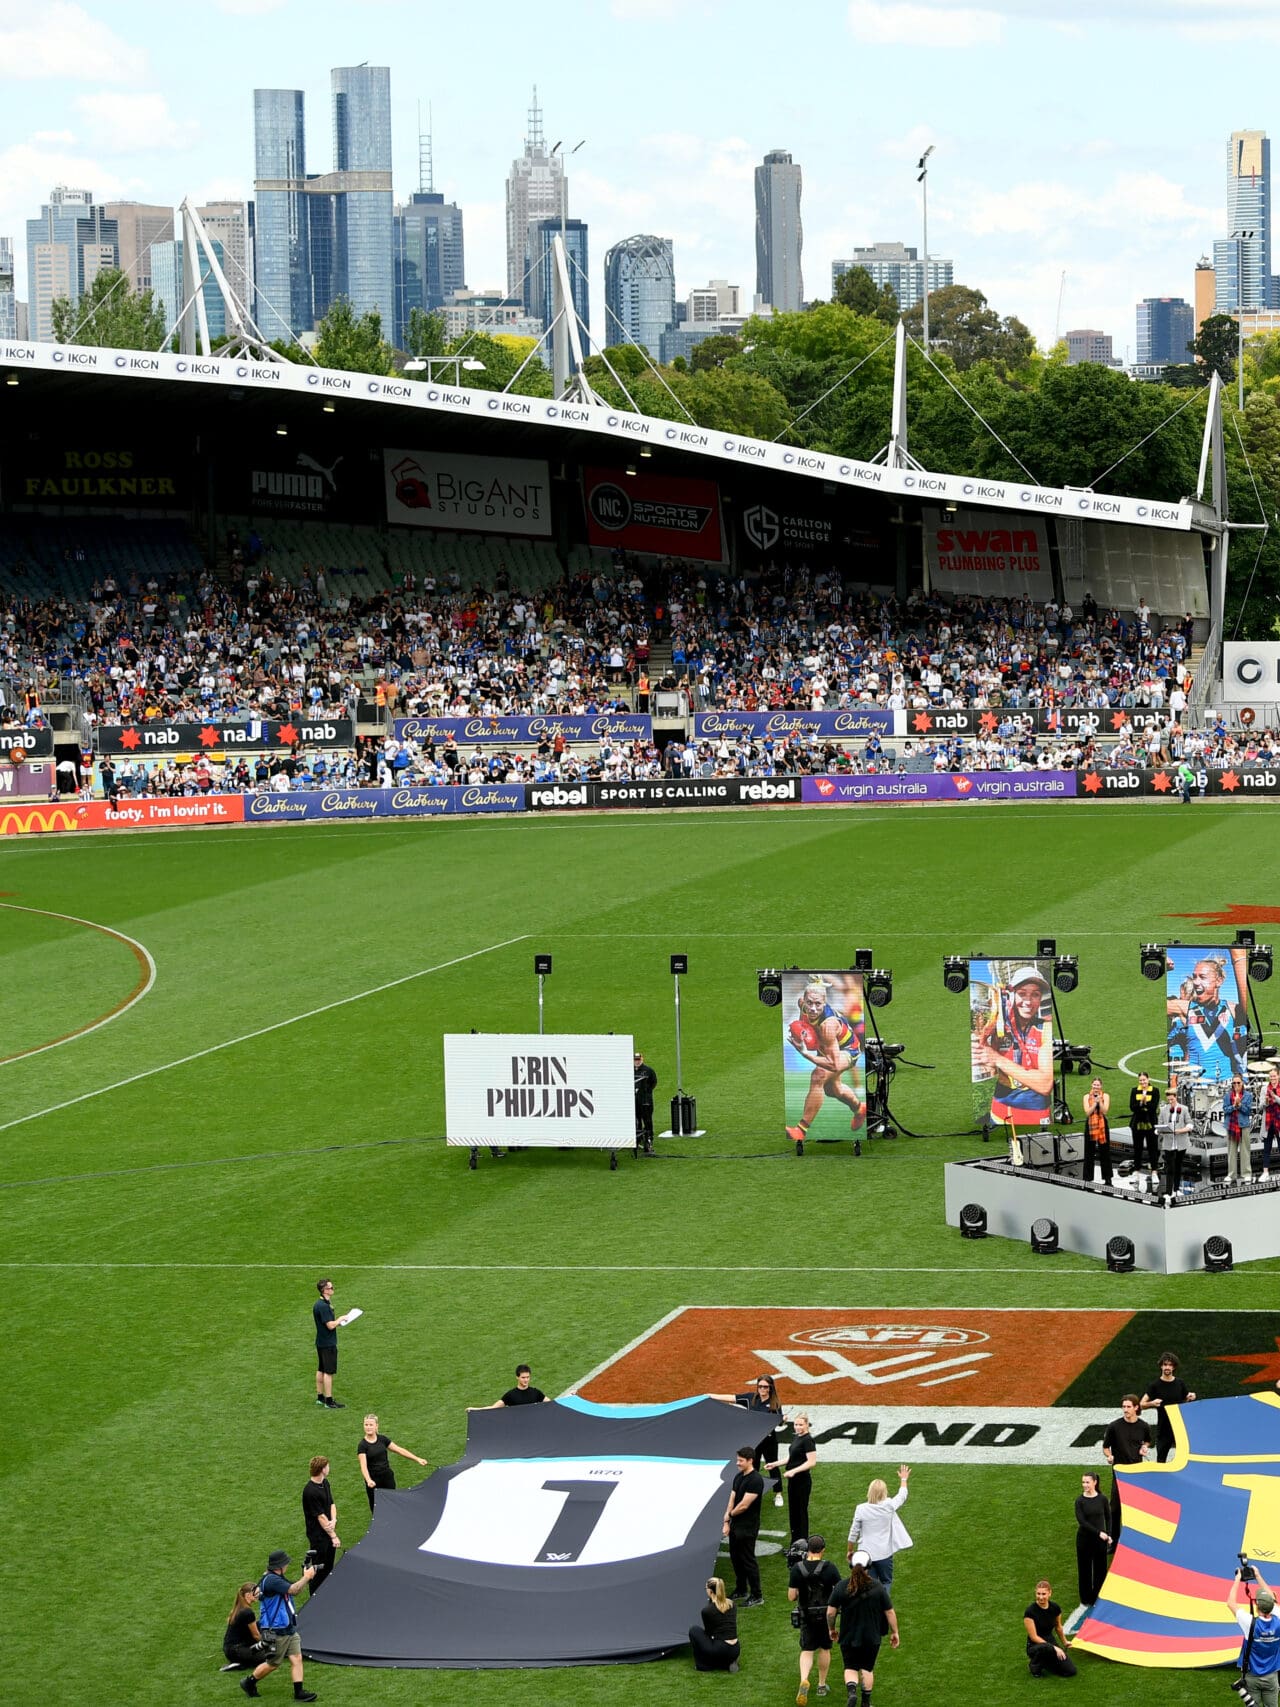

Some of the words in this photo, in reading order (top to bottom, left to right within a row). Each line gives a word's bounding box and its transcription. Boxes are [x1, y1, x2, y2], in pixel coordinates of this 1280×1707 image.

[5, 348, 35, 359] IKON
[68, 352, 97, 365] IKON
[130, 358, 159, 370] IKON
[191, 363, 220, 375] IKON
[251, 368, 280, 380] IKON
[322, 376, 351, 389] IKON
[383, 384, 412, 397] IKON
[442, 393, 470, 406] IKON
[502, 401, 531, 414] IKON
[561, 409, 589, 422] IKON
[621, 420, 650, 434] IKON
[680, 431, 708, 446] IKON
[737, 444, 766, 458] IKON
[64, 451, 133, 469] ROSS
[797, 456, 825, 470] IKON
[853, 468, 881, 482] IKON
[25, 478, 176, 496] FAULKNER
[252, 471, 323, 498] PUMA
[918, 478, 946, 491] IKON
[977, 486, 1005, 499] IKON
[598, 497, 624, 518] INC.
[1034, 493, 1062, 506] IKON
[1092, 501, 1121, 513] IKON
[438, 502, 540, 519] STUDIOS
[633, 503, 698, 519] SPORTS
[1151, 508, 1179, 520] IKON
[633, 513, 698, 529] NUTRITION
[783, 516, 832, 530] CARLTON
[784, 528, 830, 542] COLLEGE
[936, 529, 1038, 553] swan
[939, 556, 1006, 571] PLUMBING
[1009, 556, 1041, 571] PLUS
[591, 717, 645, 737] Cadbury
[701, 714, 755, 734] Cadbury
[768, 713, 822, 733] Cadbury
[834, 713, 888, 733] Cadbury
[936, 712, 968, 729] nab
[1003, 712, 1033, 728] ab
[1067, 712, 1100, 728] nab
[144, 728, 180, 745] nab
[302, 724, 336, 740] nab
[402, 720, 455, 740] Cadbury
[1, 732, 36, 749] nab
[1106, 772, 1140, 789] nab
[1243, 771, 1277, 787] nab
[601, 788, 646, 800] SPORT
[651, 787, 663, 798] IS
[666, 786, 727, 798] CALLING
[740, 780, 795, 800] rebel
[839, 783, 873, 798] virgin
[877, 783, 928, 795] australia
[976, 780, 1011, 795] virgin
[1014, 780, 1065, 792] australia
[321, 792, 378, 813] Cadbury
[391, 789, 449, 812] Cadbury
[461, 787, 519, 808] Cadbury
[532, 786, 587, 806] rebel
[105, 808, 145, 821] footy.
[149, 806, 171, 818] i'm
[174, 803, 210, 817] lovin'
[213, 802, 227, 815] it.
[250, 795, 308, 816] Cadbury
[511, 1056, 567, 1085] ERIN
[486, 1088, 594, 1119] PHILLIPS
[812, 1329, 968, 1343] AFL
[534, 1479, 620, 1563] 1
